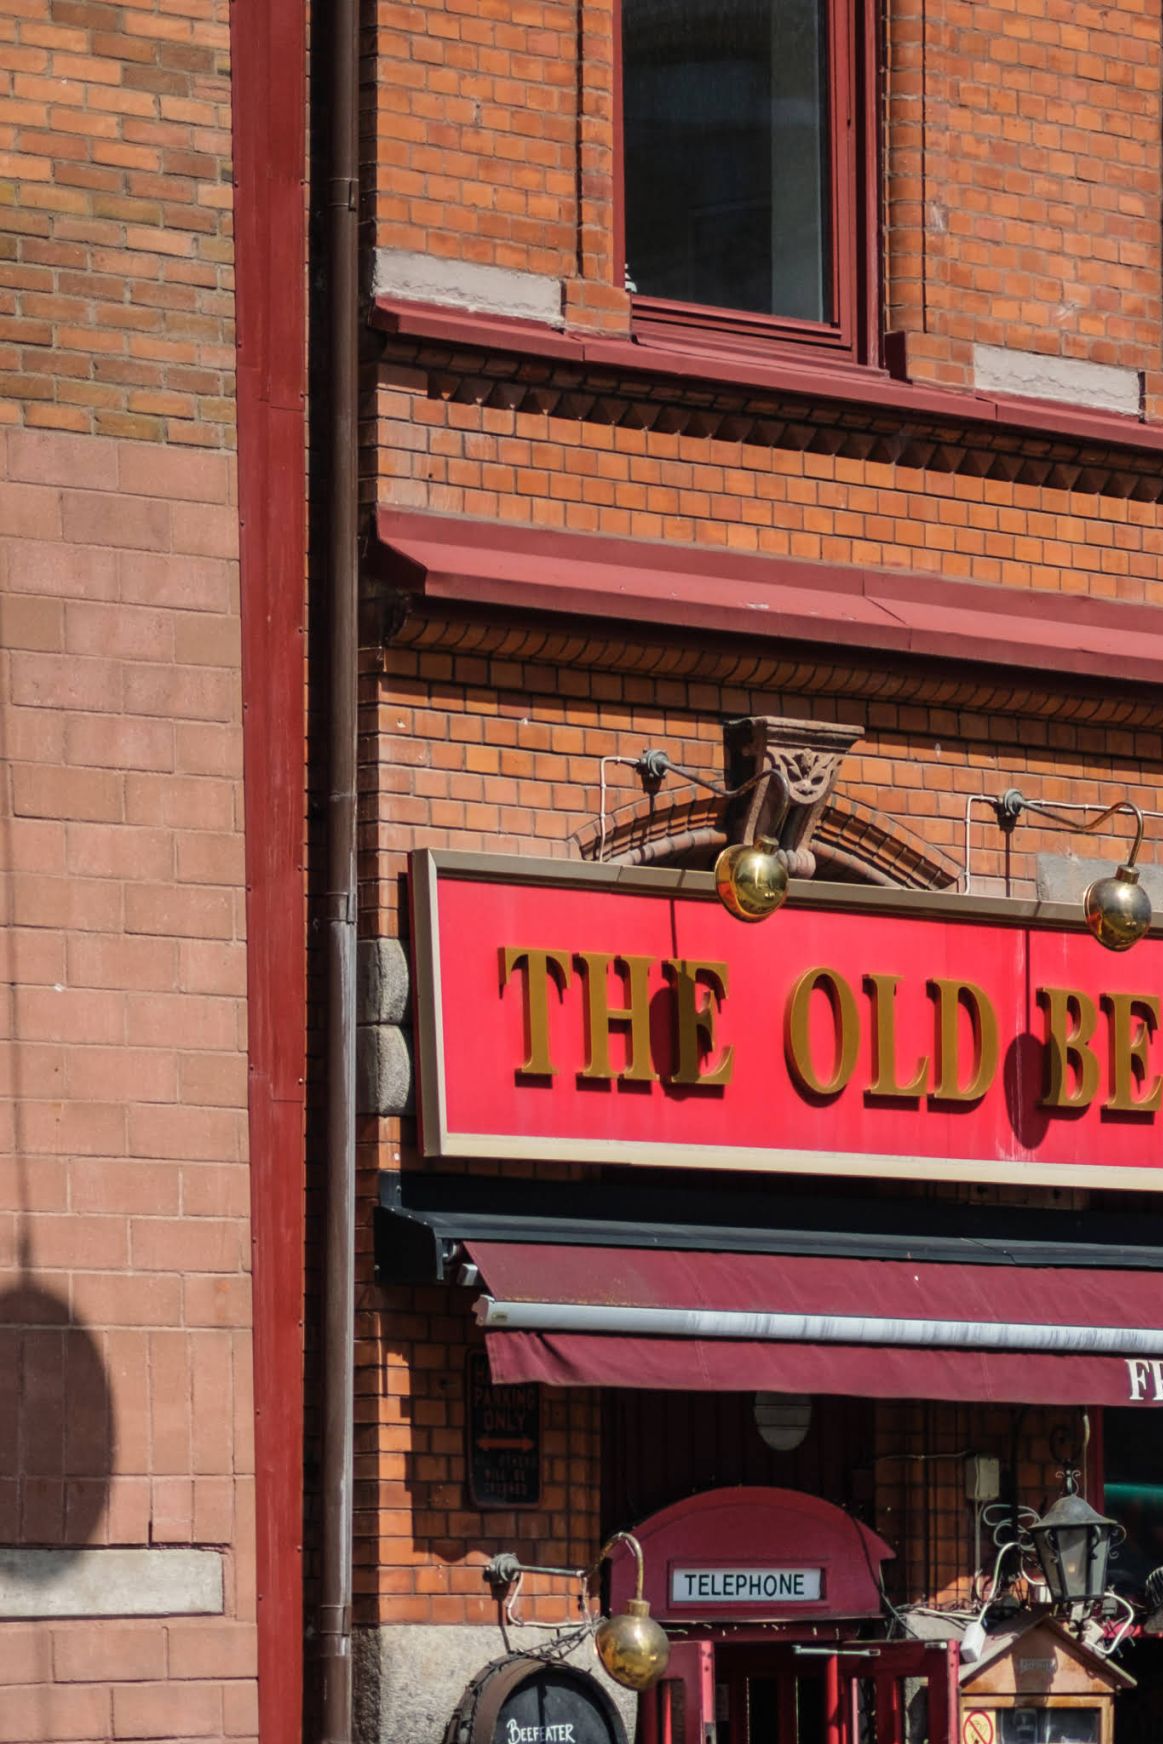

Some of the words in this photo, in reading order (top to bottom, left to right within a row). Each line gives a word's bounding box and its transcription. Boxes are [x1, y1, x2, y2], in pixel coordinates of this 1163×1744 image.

[498, 946, 735, 1086] THE
[785, 967, 998, 1102] OLD
[684, 1574, 805, 1597] TELEPHONE
[507, 1719, 576, 1744] BEEFEATER
